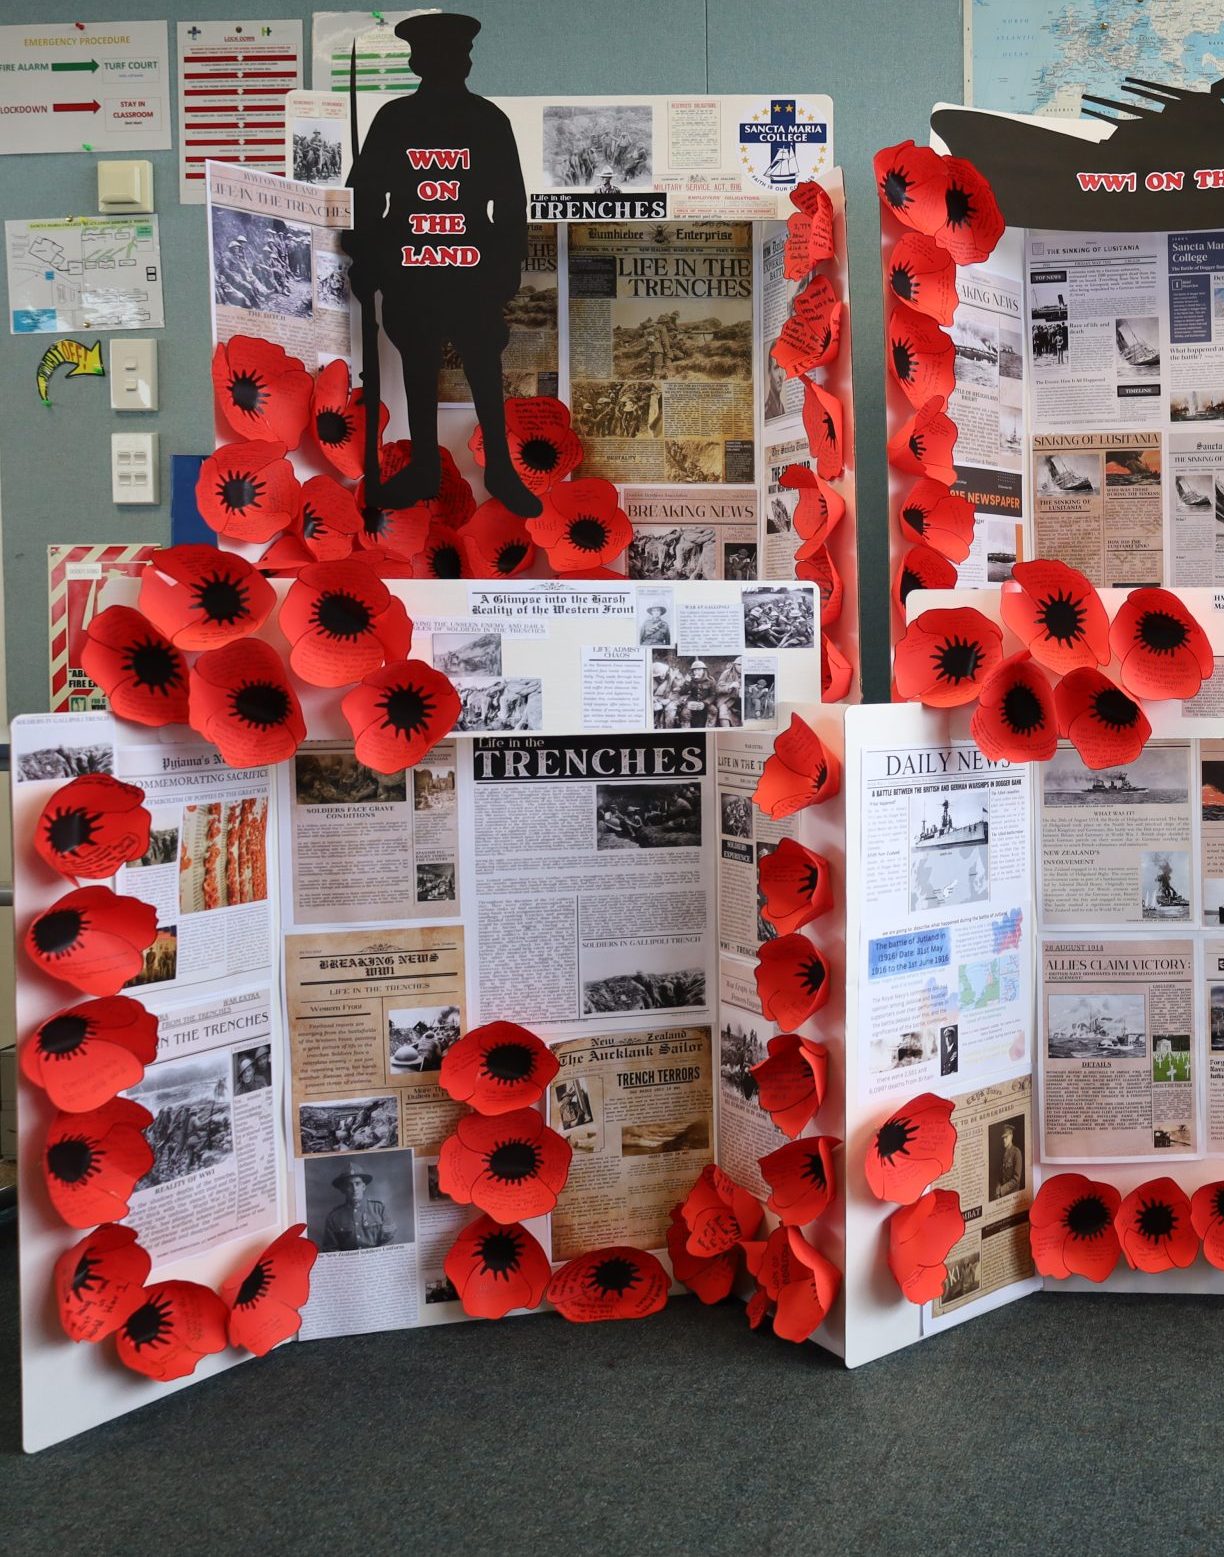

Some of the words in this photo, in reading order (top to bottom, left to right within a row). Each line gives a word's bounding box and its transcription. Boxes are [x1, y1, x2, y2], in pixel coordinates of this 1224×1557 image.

[24, 38, 77, 47] EMERGENCY
[80, 36, 131, 44] PROCEDURE
[17, 63, 49, 71] ALARM
[104, 62, 126, 70] TURF
[128, 61, 157, 69] COURT
[0, 106, 48, 114] LOCKDOWN
[744, 124, 786, 134] SANCTA
[788, 124, 822, 134] MARIA
[759, 133, 808, 143] COLLEGE
[406, 148, 471, 171] WW1
[1077, 171, 1137, 193] WW1
[1145, 170, 1186, 192] ON
[417, 180, 459, 201] ON
[531, 201, 666, 219] TRENCHES
[409, 213, 466, 236] THE
[588, 228, 644, 240] Bumblebee
[676, 228, 732, 242] Enterprise
[1172, 242, 1204, 252] Sancta
[401, 245, 481, 268] LAND
[1172, 252, 1208, 264] College
[618, 258, 669, 277] LIFE
[675, 257, 697, 277] IN
[703, 257, 751, 277] THE
[628, 278, 751, 297] TRENCHES
[967, 493, 1020, 509] NEWSPAPER
[627, 504, 708, 519] BREAKING
[711, 504, 754, 518] NEWS
[479, 595, 489, 605] A
[492, 594, 540, 606] Glimpse
[544, 594, 569, 604] into
[573, 594, 589, 603] the
[592, 594, 626, 604] Harsh
[471, 605, 512, 617] Reality
[516, 605, 527, 615] of
[529, 605, 548, 615] the
[552, 604, 599, 615] Western
[602, 604, 635, 615] Front
[478, 737, 504, 749] Life
[509, 737, 524, 749] in
[528, 737, 545, 748] the
[474, 747, 704, 779] TRENCHES
[886, 752, 952, 776] DAILY
[306, 807, 344, 815] SOLDIERS
[346, 806, 367, 814] FACE
[369, 805, 395, 813] GRAVE
[325, 812, 376, 820] CONDITIONS
[320, 956, 395, 969] BREAKING
[398, 953, 439, 963] NEWS
[1046, 960, 1088, 971] ALLIES
[1090, 960, 1129, 970] CLAIM
[1133, 959, 1191, 970] VICTORY:
[365, 967, 395, 977] WW1
[559, 1054, 584, 1068] The
[589, 1048, 654, 1062] Aucklank
[659, 1042, 703, 1055] Sailor
[617, 1071, 654, 1087] TRENCH
[656, 1066, 700, 1084] TERRORS
